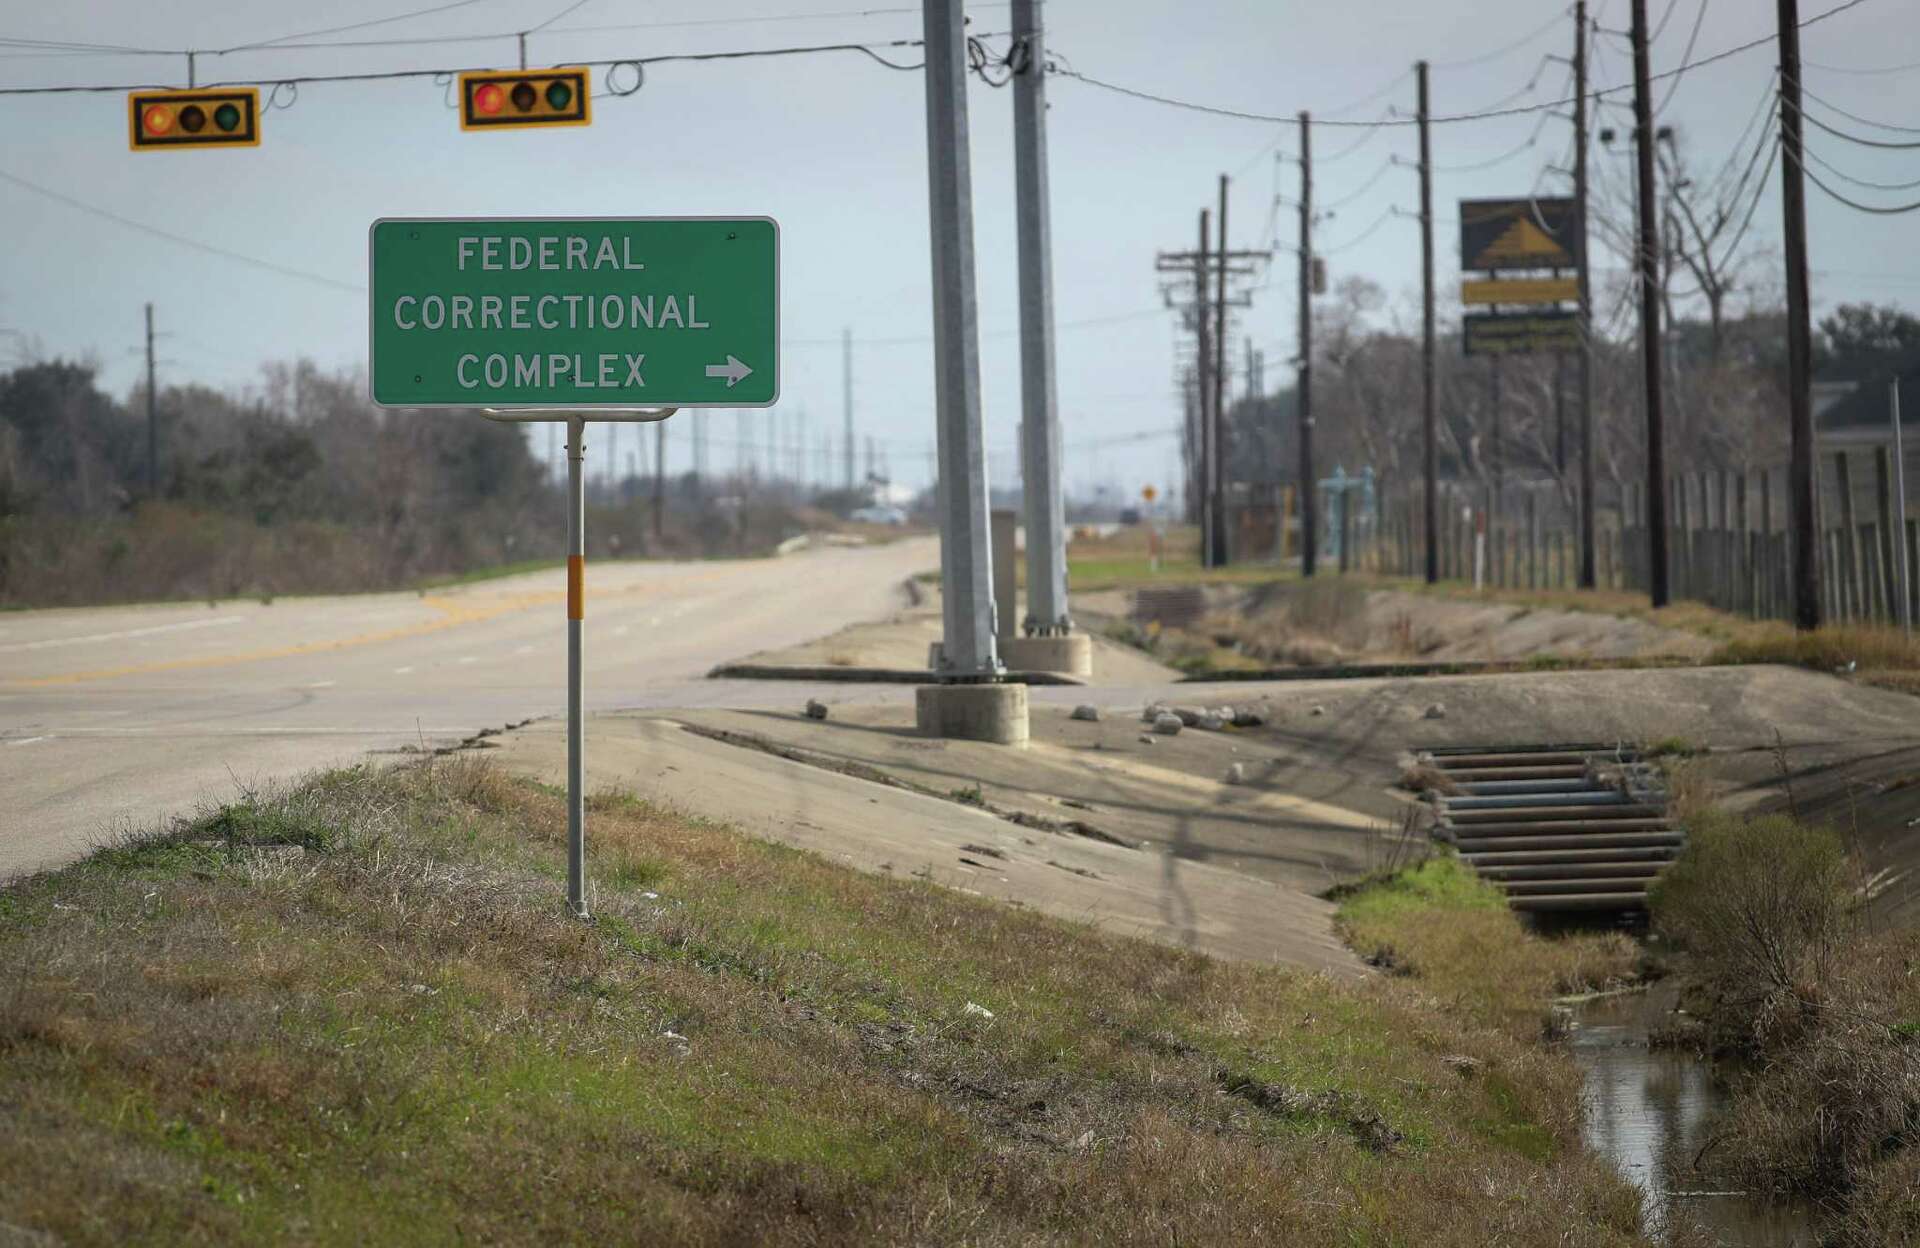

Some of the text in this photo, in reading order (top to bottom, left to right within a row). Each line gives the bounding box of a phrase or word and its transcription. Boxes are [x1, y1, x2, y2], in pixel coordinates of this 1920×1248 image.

[457, 236, 645, 271] FEDERAL
[393, 294, 710, 331] CORRECTIONAL
[456, 353, 646, 389] COMPLEX
